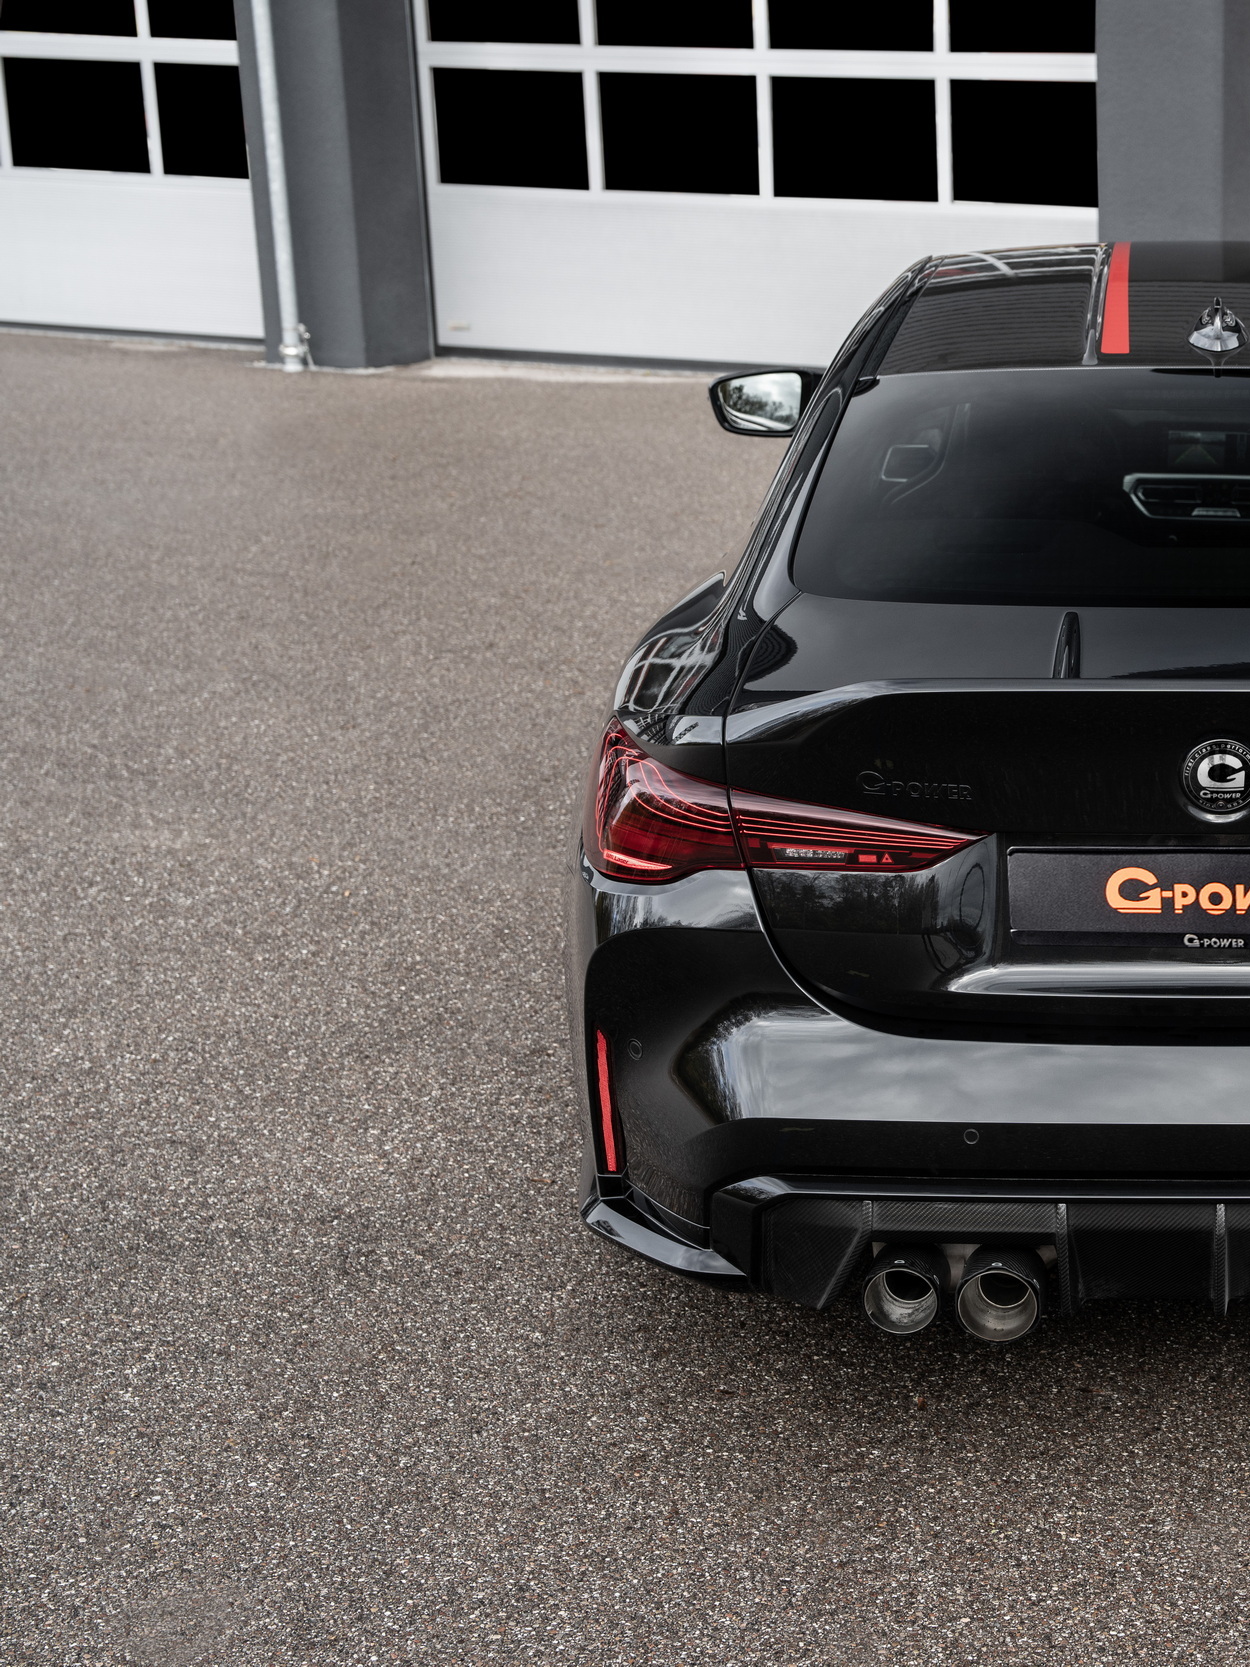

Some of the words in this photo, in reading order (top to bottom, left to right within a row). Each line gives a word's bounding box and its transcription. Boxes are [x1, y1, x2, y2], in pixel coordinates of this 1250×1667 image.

[855, 770, 974, 800] G-POWER
[1199, 790, 1241, 799] G-POWER
[1183, 933, 1245, 948] G-POWER
